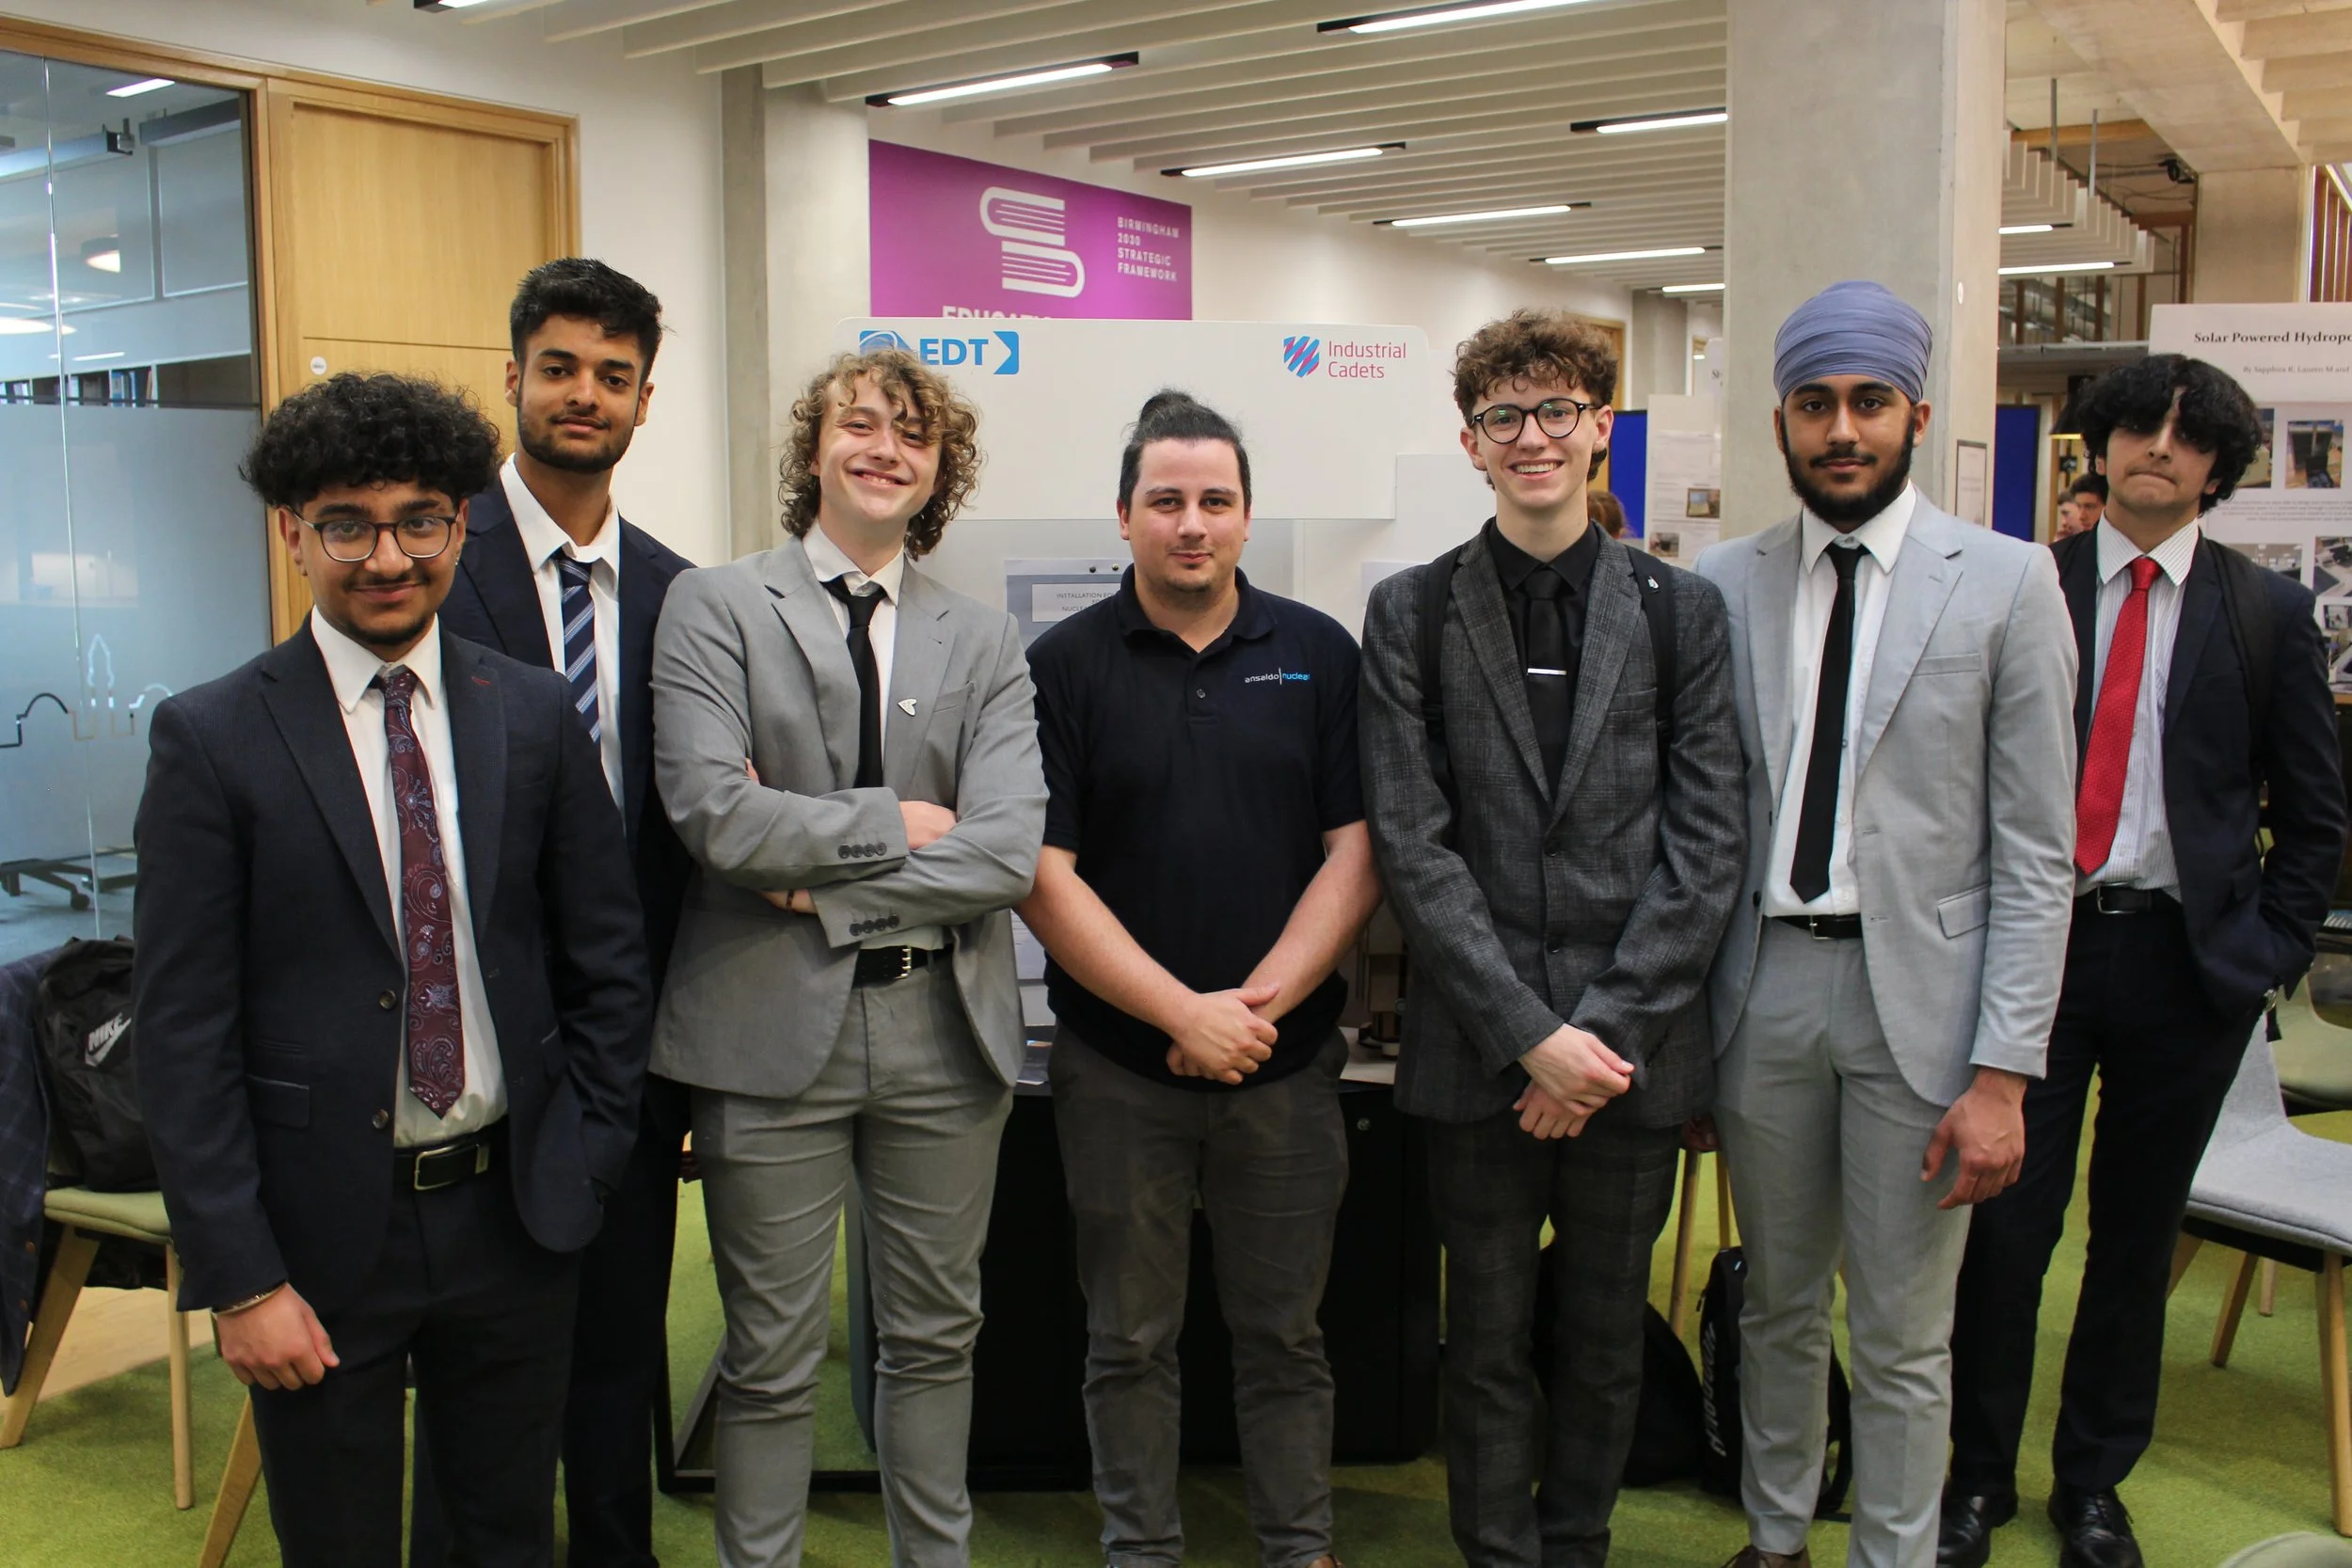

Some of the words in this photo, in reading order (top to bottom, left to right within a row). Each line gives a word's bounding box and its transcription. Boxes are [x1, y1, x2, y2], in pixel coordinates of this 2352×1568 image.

[1117, 216, 1180, 239] BIRMINGHAM
[1117, 232, 1141, 246] 2030
[1117, 246, 1172, 267] STRATEGIC
[1117, 261, 1178, 282] FRAMEWORK
[2193, 331, 2229, 343] Solar
[2232, 331, 2290, 343] Powered
[919, 338, 989, 366] EDT
[1327, 341, 1406, 358] Industrial
[1327, 360, 1385, 378] Cadets
[1245, 673, 1279, 683] ansaldo
